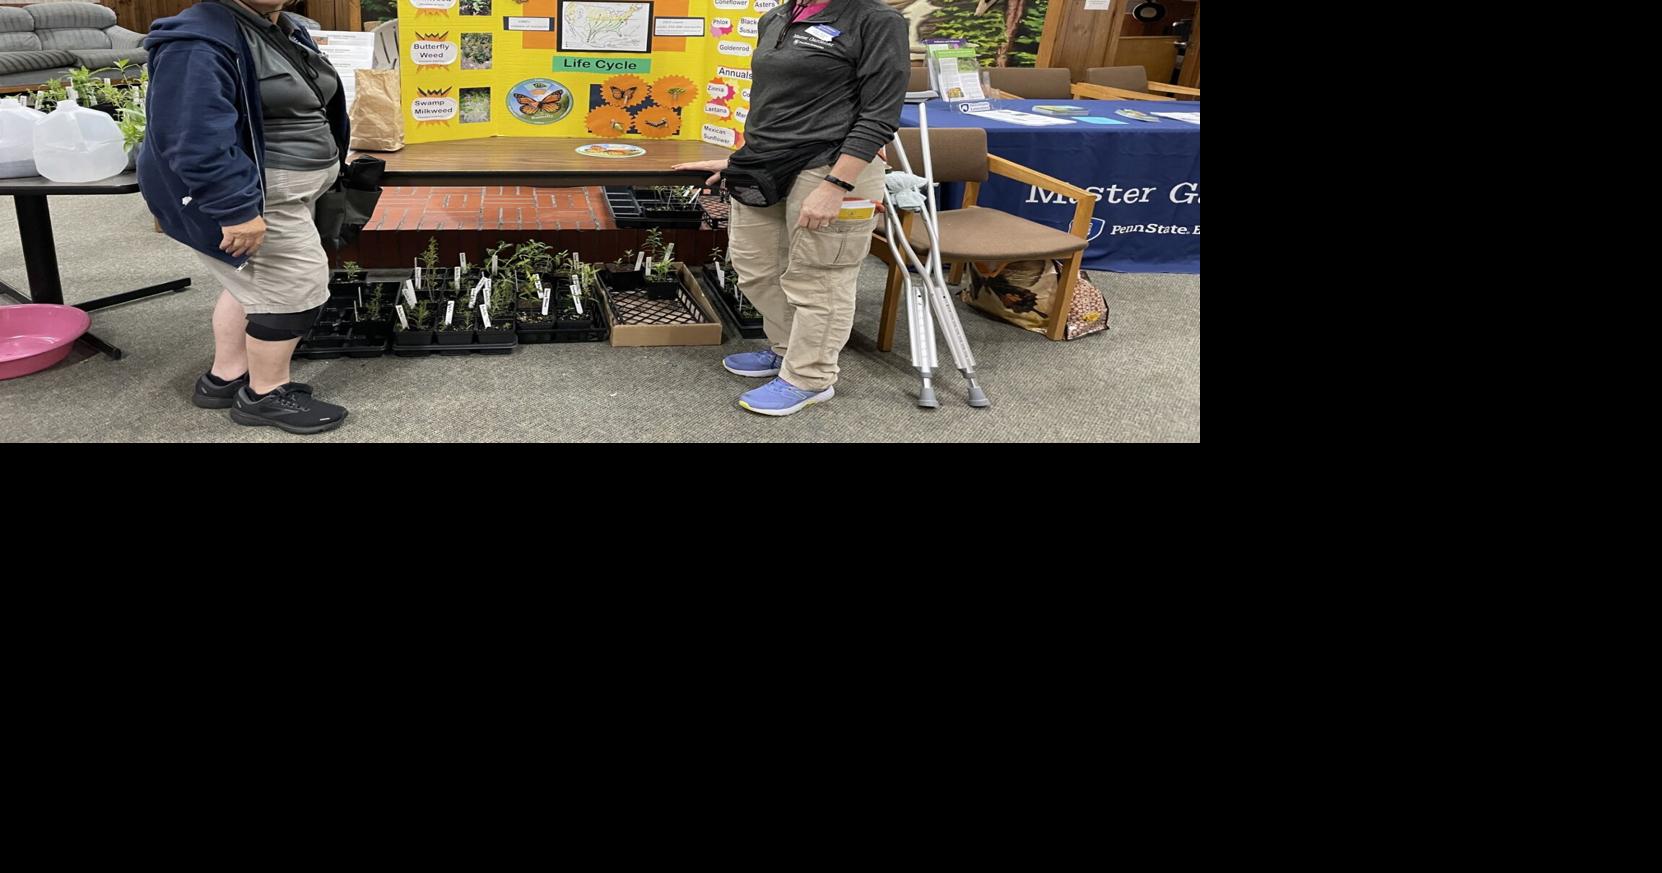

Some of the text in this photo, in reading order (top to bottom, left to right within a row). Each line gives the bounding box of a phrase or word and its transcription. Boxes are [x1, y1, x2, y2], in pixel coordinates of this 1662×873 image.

[413, 43, 449, 51] Butterfly
[720, 44, 750, 52] Goldenrod
[563, 58, 637, 71] Life Cycle
[719, 67, 752, 79] Annuals
[704, 125, 726, 134] Mexican
[704, 134, 729, 143] Sunflower
[1025, 183, 1157, 204] Mster
